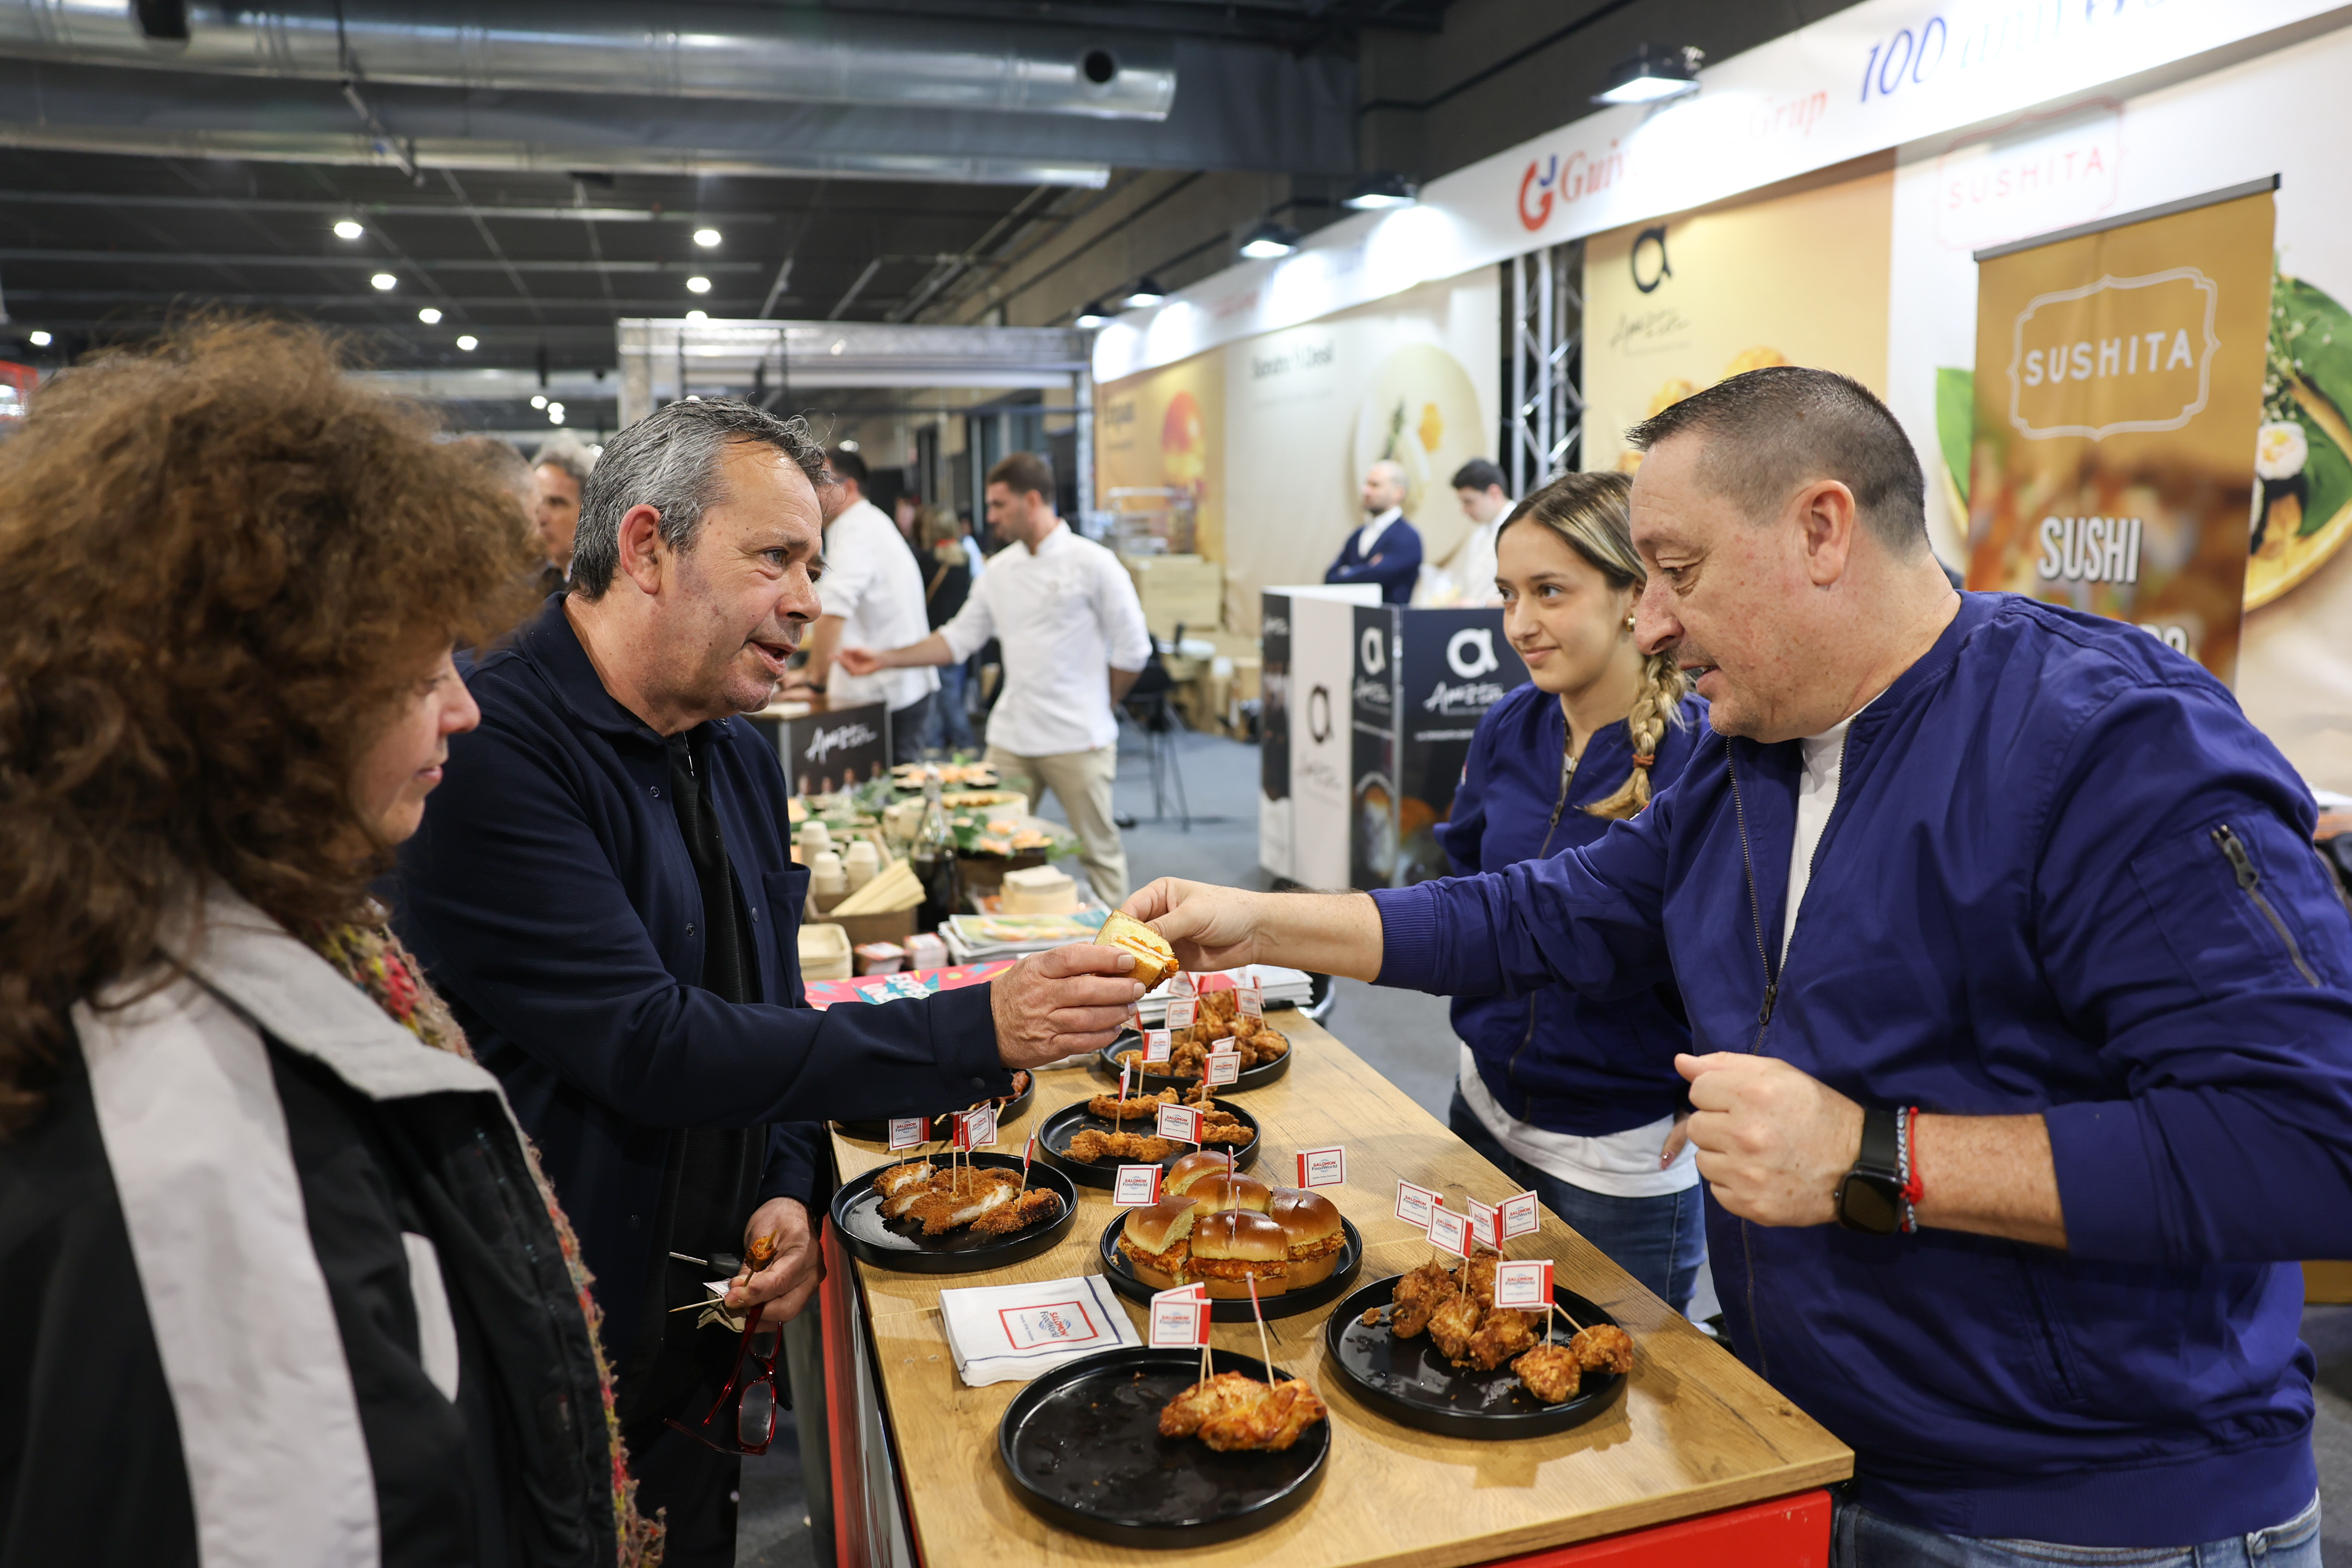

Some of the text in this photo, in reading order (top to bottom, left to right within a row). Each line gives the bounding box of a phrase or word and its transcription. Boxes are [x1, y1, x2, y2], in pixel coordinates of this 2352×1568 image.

[1859, 16, 1947, 103] 100
[1948, 146, 2105, 210] SUSHITA
[2024, 327, 2194, 387] SUSHITA
[2038, 515, 2144, 583] SUSHI
[973, 1117, 986, 1127] SALOMON
[1403, 1198, 1427, 1210] FoodWorld
[1405, 1195, 1426, 1206] SALOMON
[1474, 1213, 1489, 1223] SALOMON
[1508, 1211, 1532, 1220] FoodWorld
[1509, 1207, 1531, 1216] SALOMON
[1435, 1221, 1458, 1235] FoodWorld
[1437, 1218, 1458, 1230] SALOMON
[1040, 1311, 1061, 1338] FoodWorld
[1050, 1312, 1068, 1336] SALOMON
